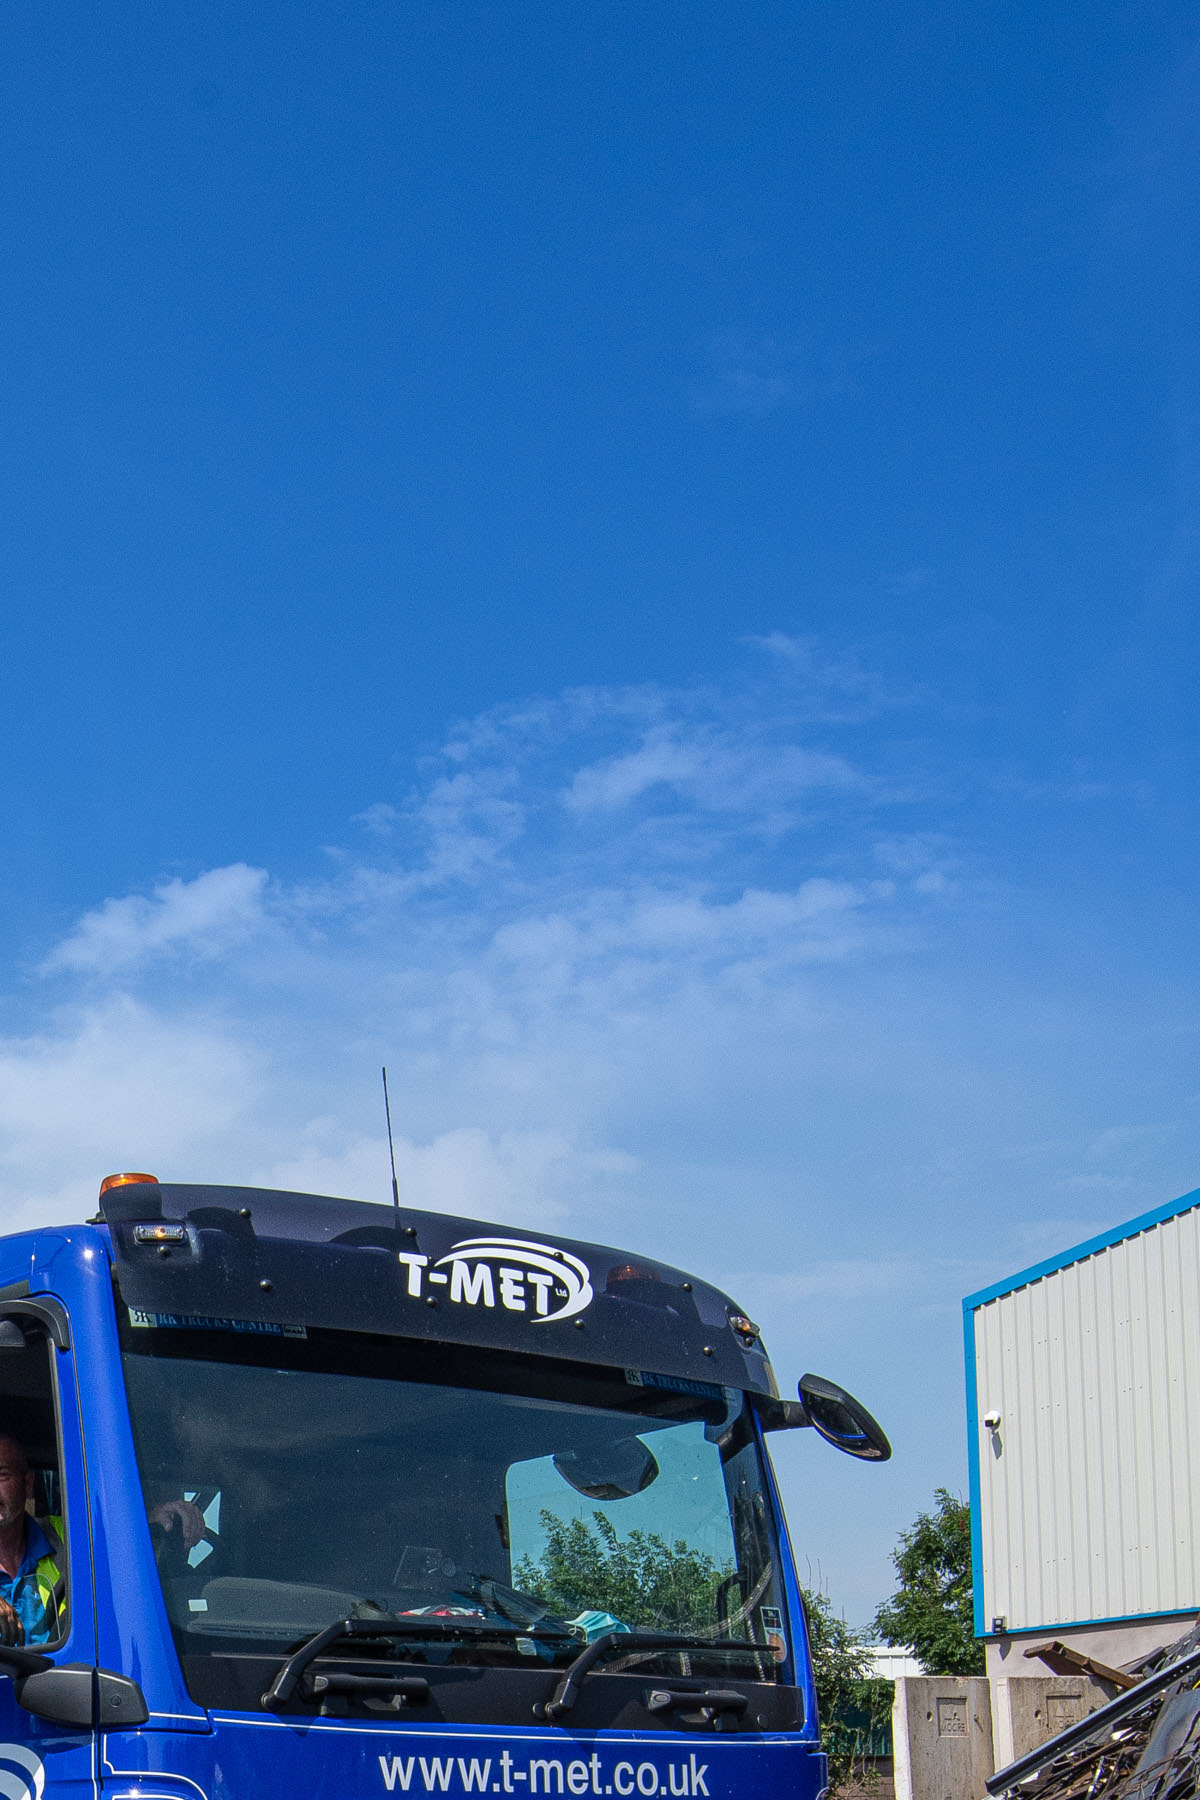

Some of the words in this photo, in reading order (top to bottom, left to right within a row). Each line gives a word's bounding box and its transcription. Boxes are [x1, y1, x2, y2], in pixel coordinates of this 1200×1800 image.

[399, 1252, 553, 1316] T-MET
[555, 1287, 568, 1298] Ltd
[378, 1750, 711, 1797] www.t-met.co.uk
